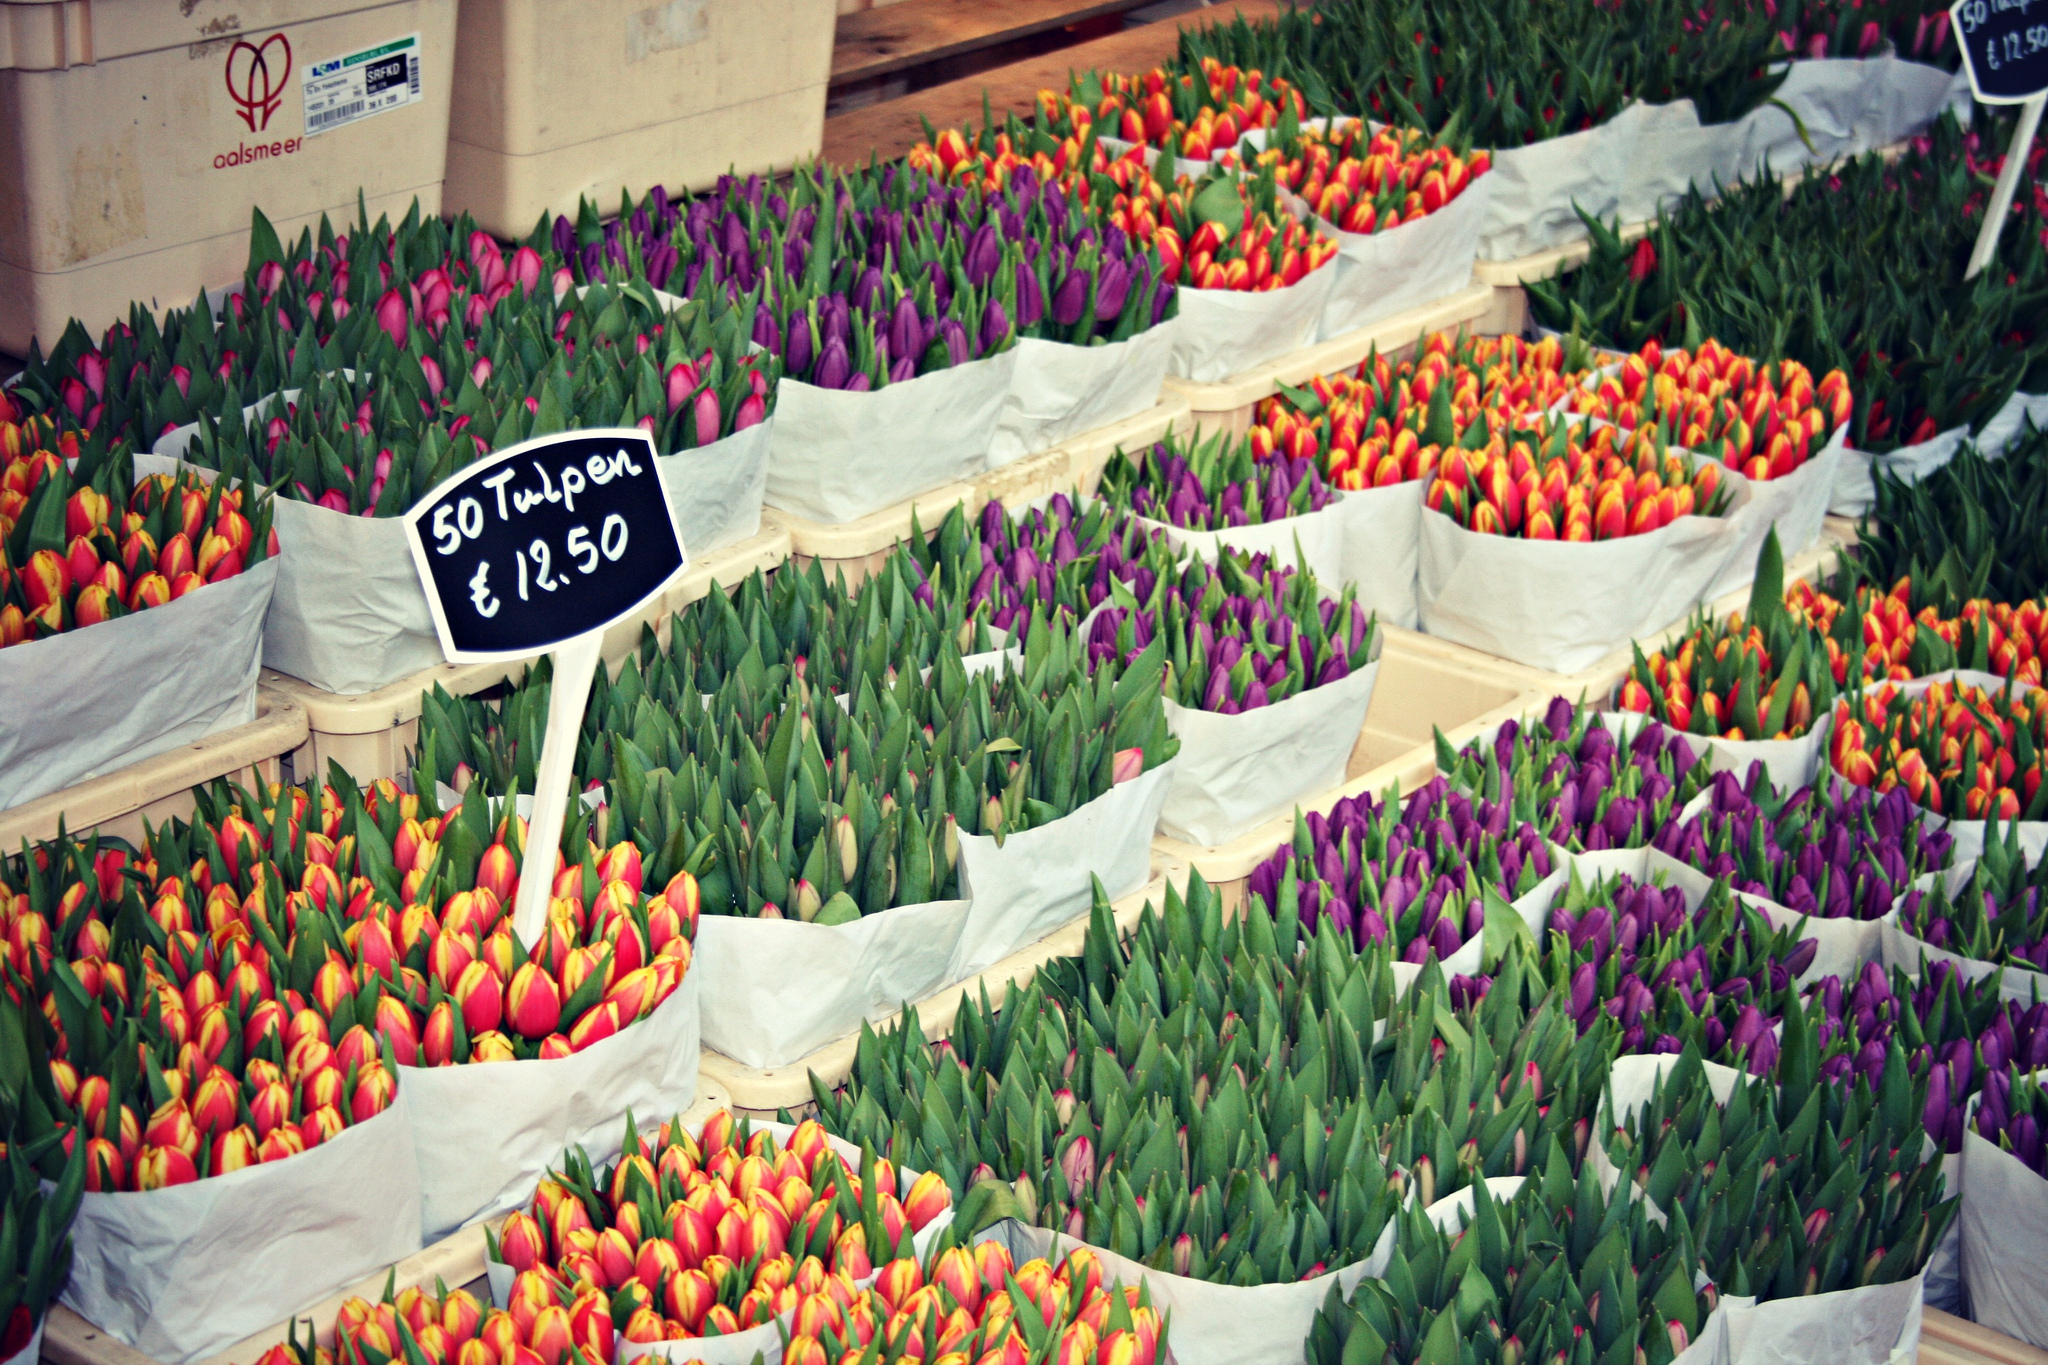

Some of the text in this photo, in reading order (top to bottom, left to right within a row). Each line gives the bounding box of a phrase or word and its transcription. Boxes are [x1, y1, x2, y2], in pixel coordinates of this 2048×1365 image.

[1963, 1, 1987, 33] 50
[2003, 25, 2048, 62] 12.50
[367, 62, 400, 83] SRFKD
[213, 136, 303, 169] aalsmeer
[433, 449, 643, 555] 50 Tulpen
[468, 514, 629, 618] € 12.50
